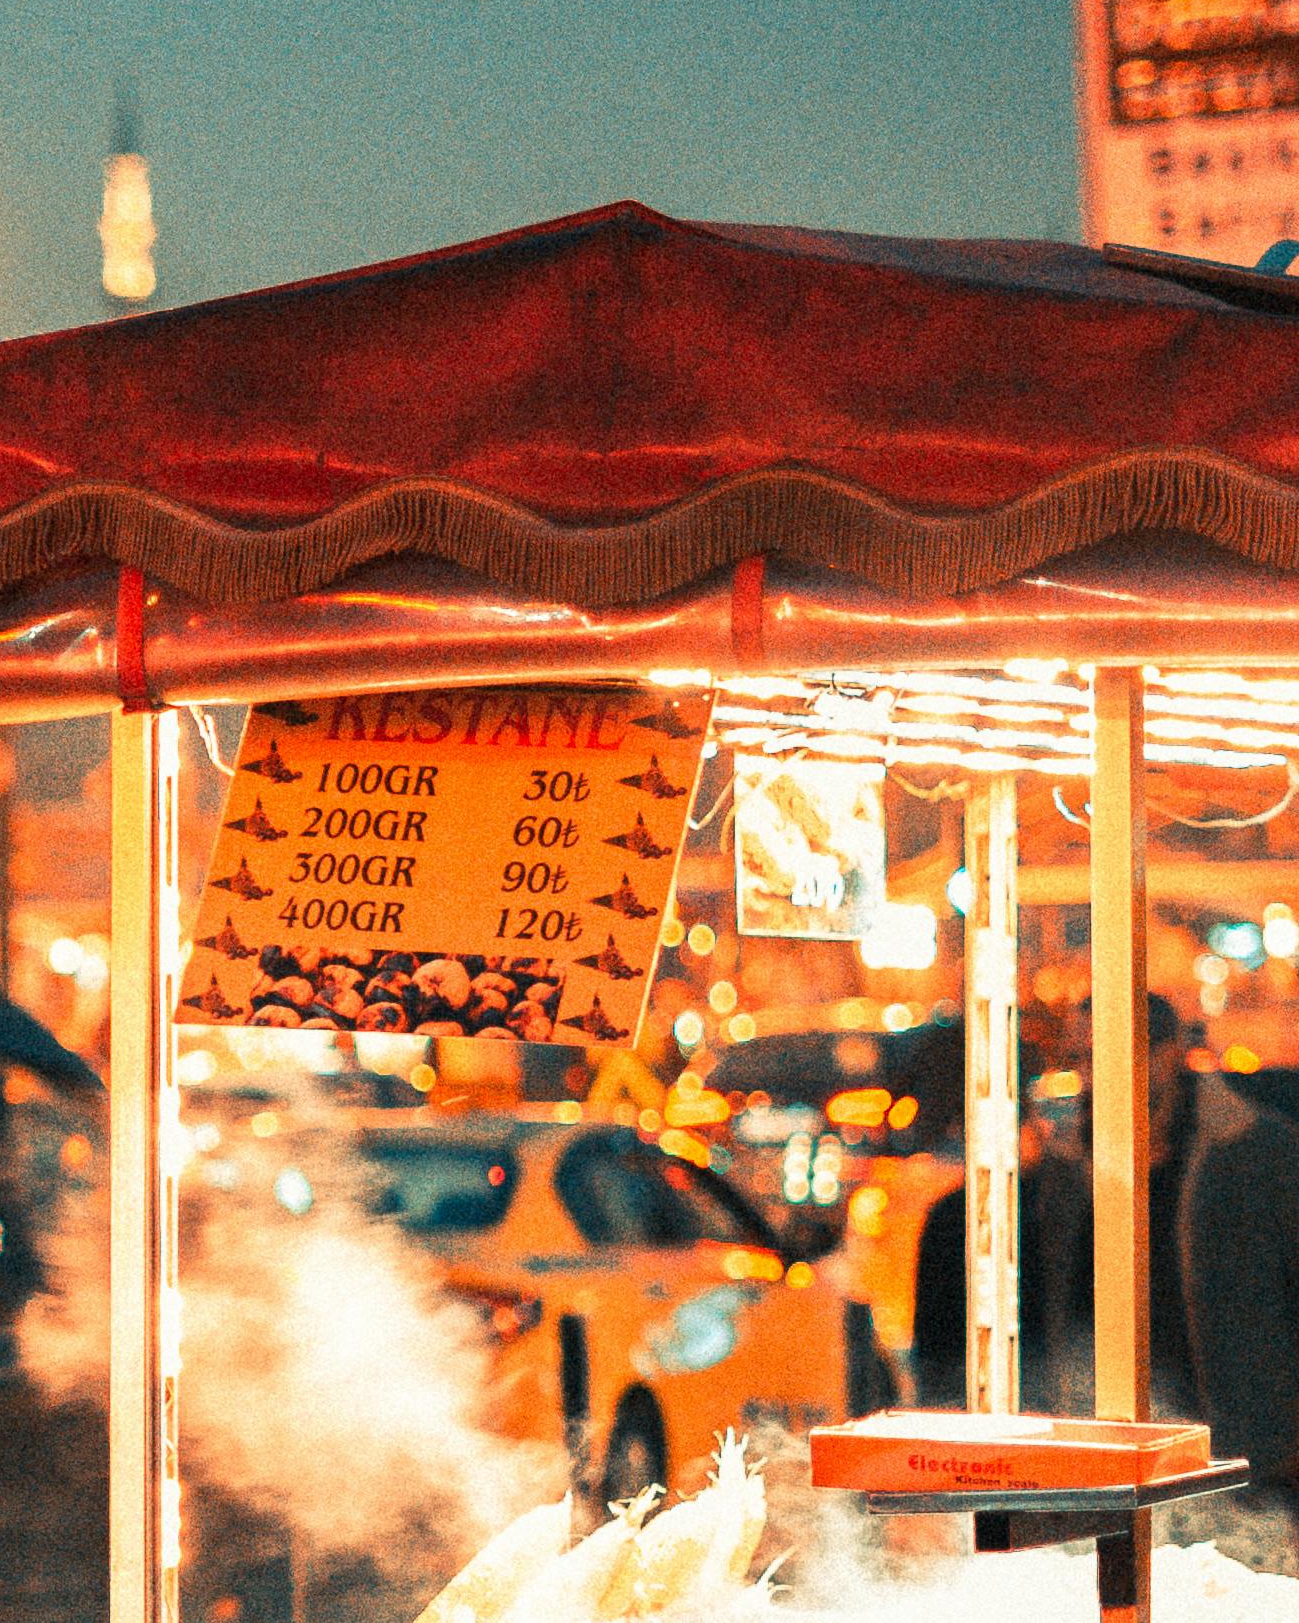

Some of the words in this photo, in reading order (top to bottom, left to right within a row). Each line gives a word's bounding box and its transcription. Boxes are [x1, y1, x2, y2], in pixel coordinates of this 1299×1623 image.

[324, 686, 631, 751] KESTANE
[317, 762, 439, 797] 100GR
[298, 806, 428, 842] 200GR
[288, 852, 417, 888] 300GR
[277, 895, 406, 933] 400GR
[907, 1453, 1014, 1476] Electronic
[954, 1475, 1001, 1487] Kitchen
